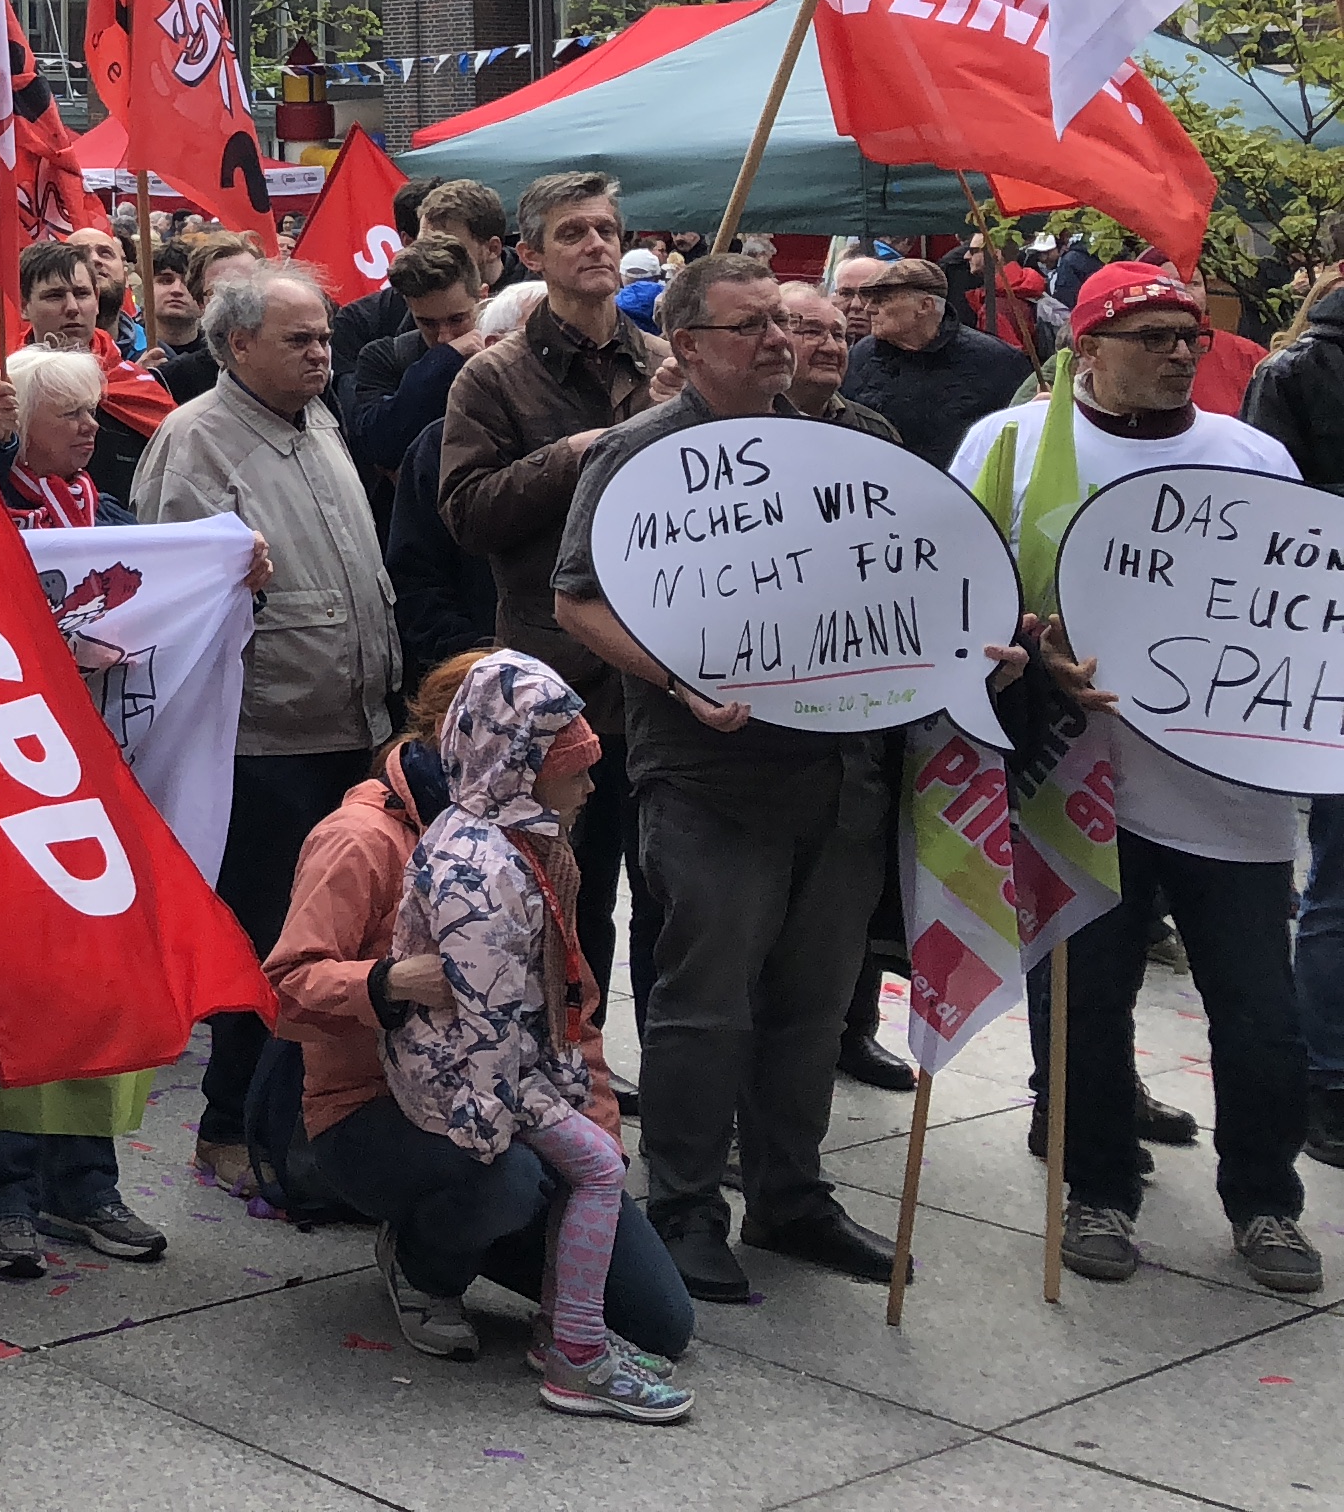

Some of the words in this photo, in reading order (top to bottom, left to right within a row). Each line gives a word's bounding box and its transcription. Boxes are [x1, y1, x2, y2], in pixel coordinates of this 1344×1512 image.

[680, 437, 771, 494] DAS
[625, 491, 784, 562] MACHEN
[813, 481, 897, 524] WIR
[1151, 483, 1251, 541] DAS
[653, 548, 813, 609] NICHT
[850, 532, 939, 582] FÜR
[1103, 537, 1175, 588] IHR
